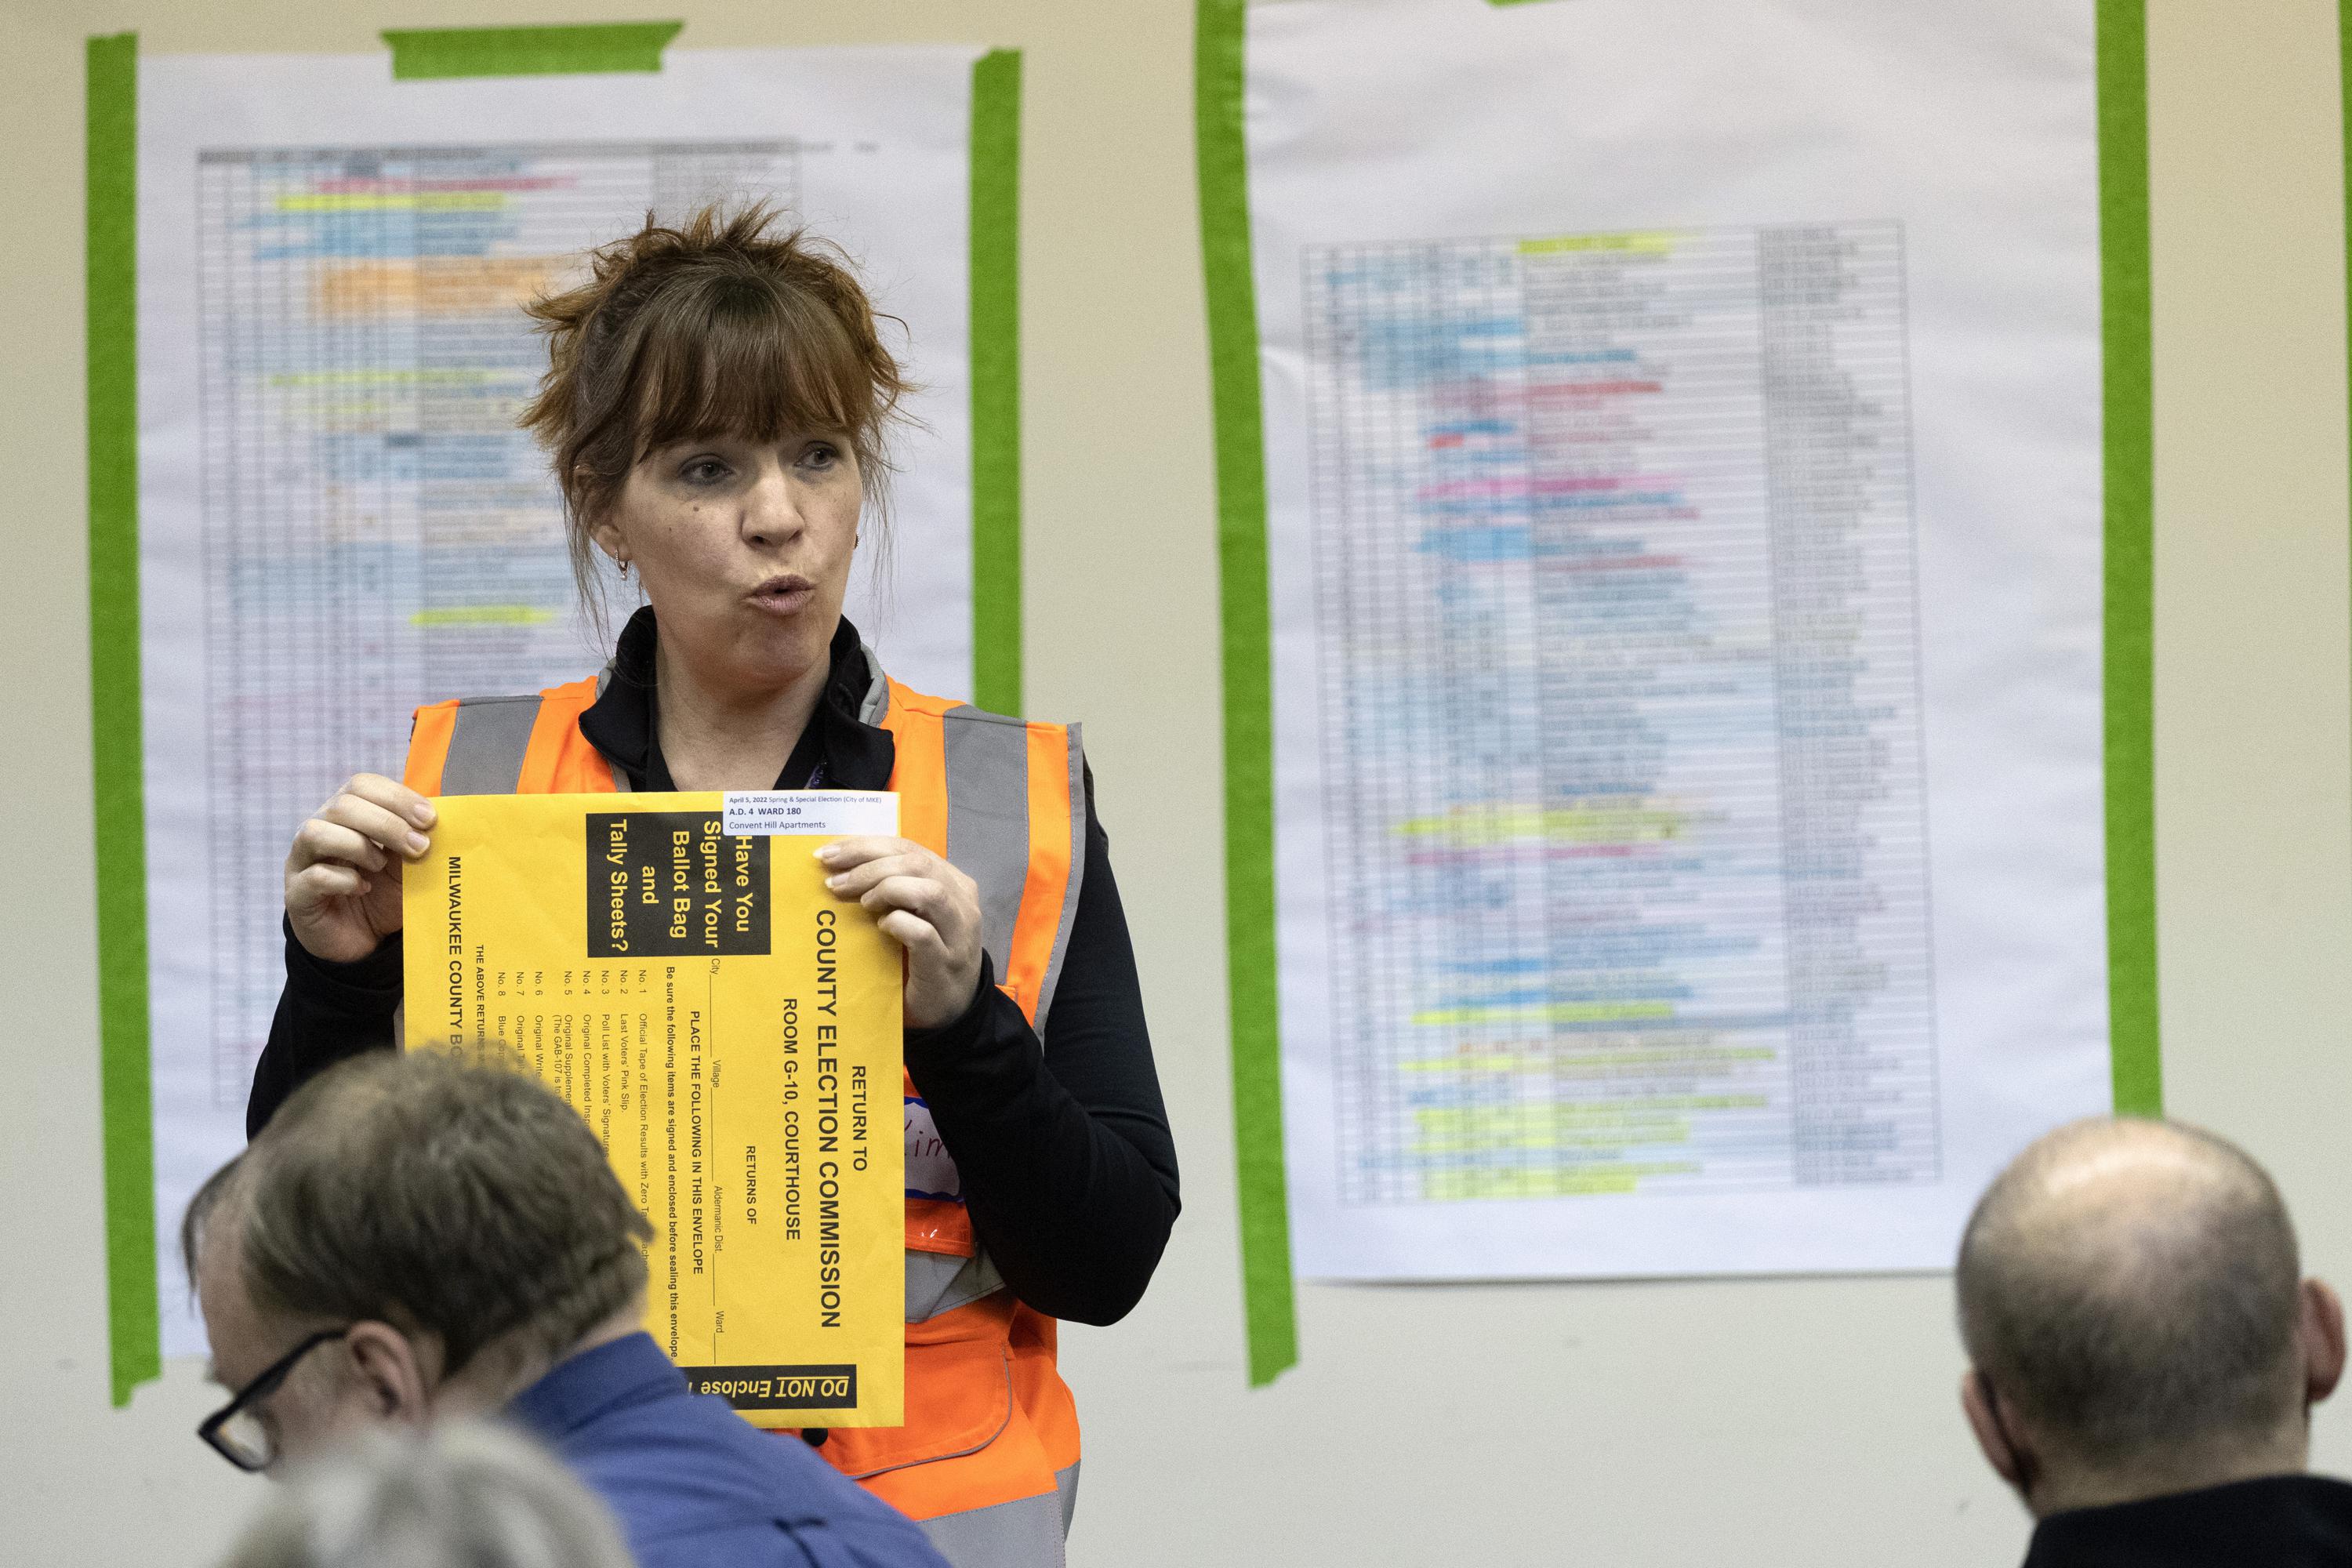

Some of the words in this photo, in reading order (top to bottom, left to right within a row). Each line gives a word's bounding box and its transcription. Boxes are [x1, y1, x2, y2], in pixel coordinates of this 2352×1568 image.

[606, 819, 628, 865] Tally
[779, 822, 826, 830] Apartments
[673, 831, 691, 891] Ballot
[700, 820, 723, 892] Signed
[735, 836, 753, 886] Have
[643, 866, 659, 903] and
[448, 857, 462, 955] MILWAUKEE
[611, 872, 629, 951] Sheets?
[670, 898, 690, 938] Bag
[705, 899, 722, 948] Your
[736, 893, 753, 931] You
[666, 967, 675, 978] Be
[710, 959, 720, 975] City
[816, 910, 837, 1016] COUNTY
[449, 960, 463, 1029] COUNTY
[476, 967, 485, 1000] ABOVE
[515, 1015, 525, 1051] Original
[534, 1015, 543, 1050] Original
[553, 1015, 563, 1033] (The
[563, 1014, 573, 1050] Original
[582, 1014, 592, 1049] Original
[690, 1011, 701, 1051] PLACE
[783, 999, 798, 1054] ROOM
[554, 1036, 562, 1073] GAB-107
[638, 1048, 647, 1069] Tape
[665, 1024, 677, 1068] following
[583, 1053, 591, 1102] Completed
[640, 1073, 648, 1081] of
[667, 1072, 676, 1098] items
[691, 1056, 700, 1079] THE
[710, 1060, 720, 1087] Village
[782, 1061, 799, 1104] G-10,
[620, 1094, 630, 1112] Slip.
[640, 1085, 648, 1120] Election
[818, 1025, 838, 1152] ELECTION
[852, 1066, 867, 1140] RETURN
[666, 1119, 677, 1151] signed
[691, 1084, 701, 1157] FOLLOWING
[691, 1162, 702, 1173] IN
[746, 1146, 757, 1204] RETURNS
[785, 1111, 800, 1240] COURTHOUSE
[853, 1147, 867, 1171] TO
[640, 1183, 649, 1203] Zero
[668, 1174, 677, 1218] enclosed
[692, 1177, 702, 1204] THIS
[714, 1186, 723, 1232] Aldermanic
[747, 1208, 757, 1224] OF
[669, 1221, 678, 1252] before
[692, 1209, 703, 1274] ENVELOPE
[819, 1162, 840, 1327] COMMISSION
[668, 1255, 679, 1290] sealing
[669, 1313, 679, 1361] envelope.
[700, 1380, 771, 1398] Enclose
[775, 1379, 816, 1397] NOT
[820, 1379, 849, 1397] DO
